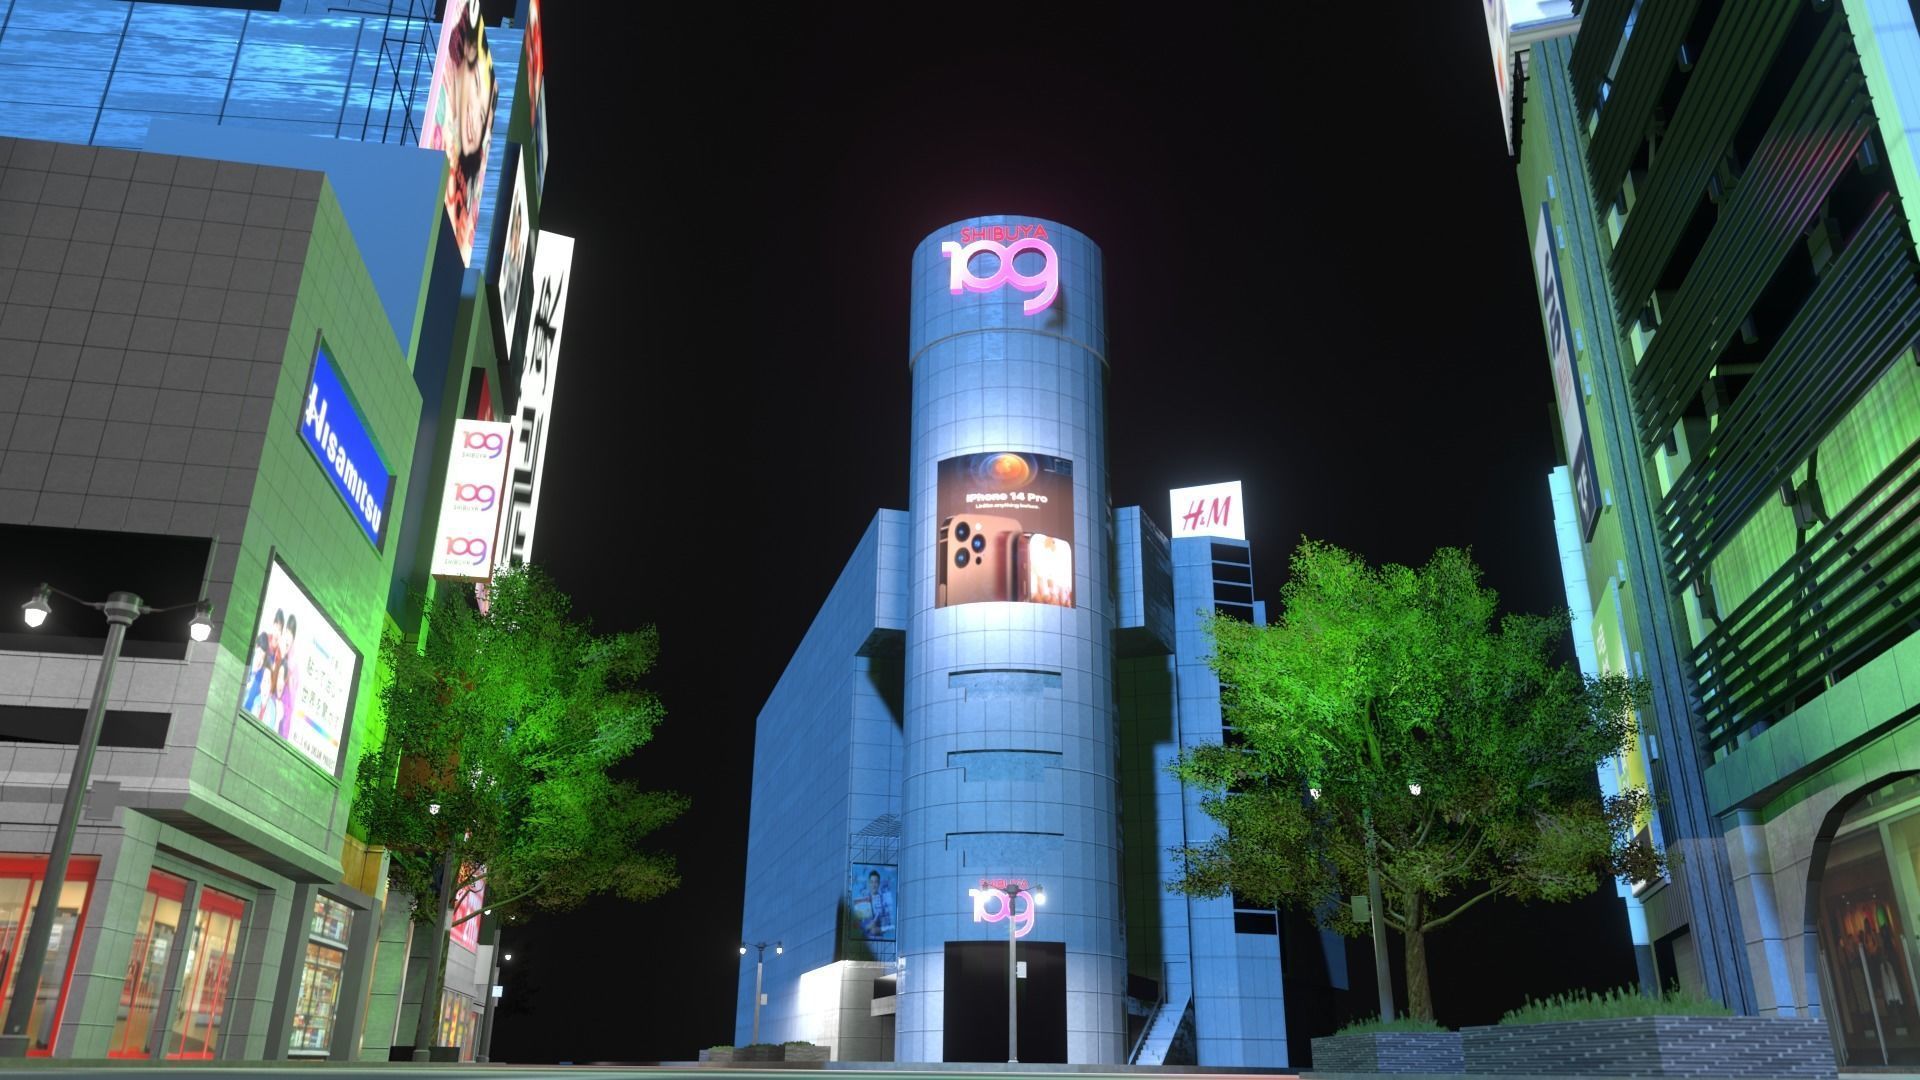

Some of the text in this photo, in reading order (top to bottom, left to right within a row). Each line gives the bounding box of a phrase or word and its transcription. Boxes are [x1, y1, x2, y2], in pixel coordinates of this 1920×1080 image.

[961, 223, 1049, 243] SHIBUYA
[942, 238, 1059, 316] 109
[305, 382, 381, 534] Hisamitsu
[463, 431, 503, 459] 109
[454, 483, 496, 512] 109
[965, 491, 1048, 503] iPhone 14 Pro
[1182, 495, 1231, 531] H&M
[446, 536, 487, 565] 109
[969, 889, 1034, 938] 109
